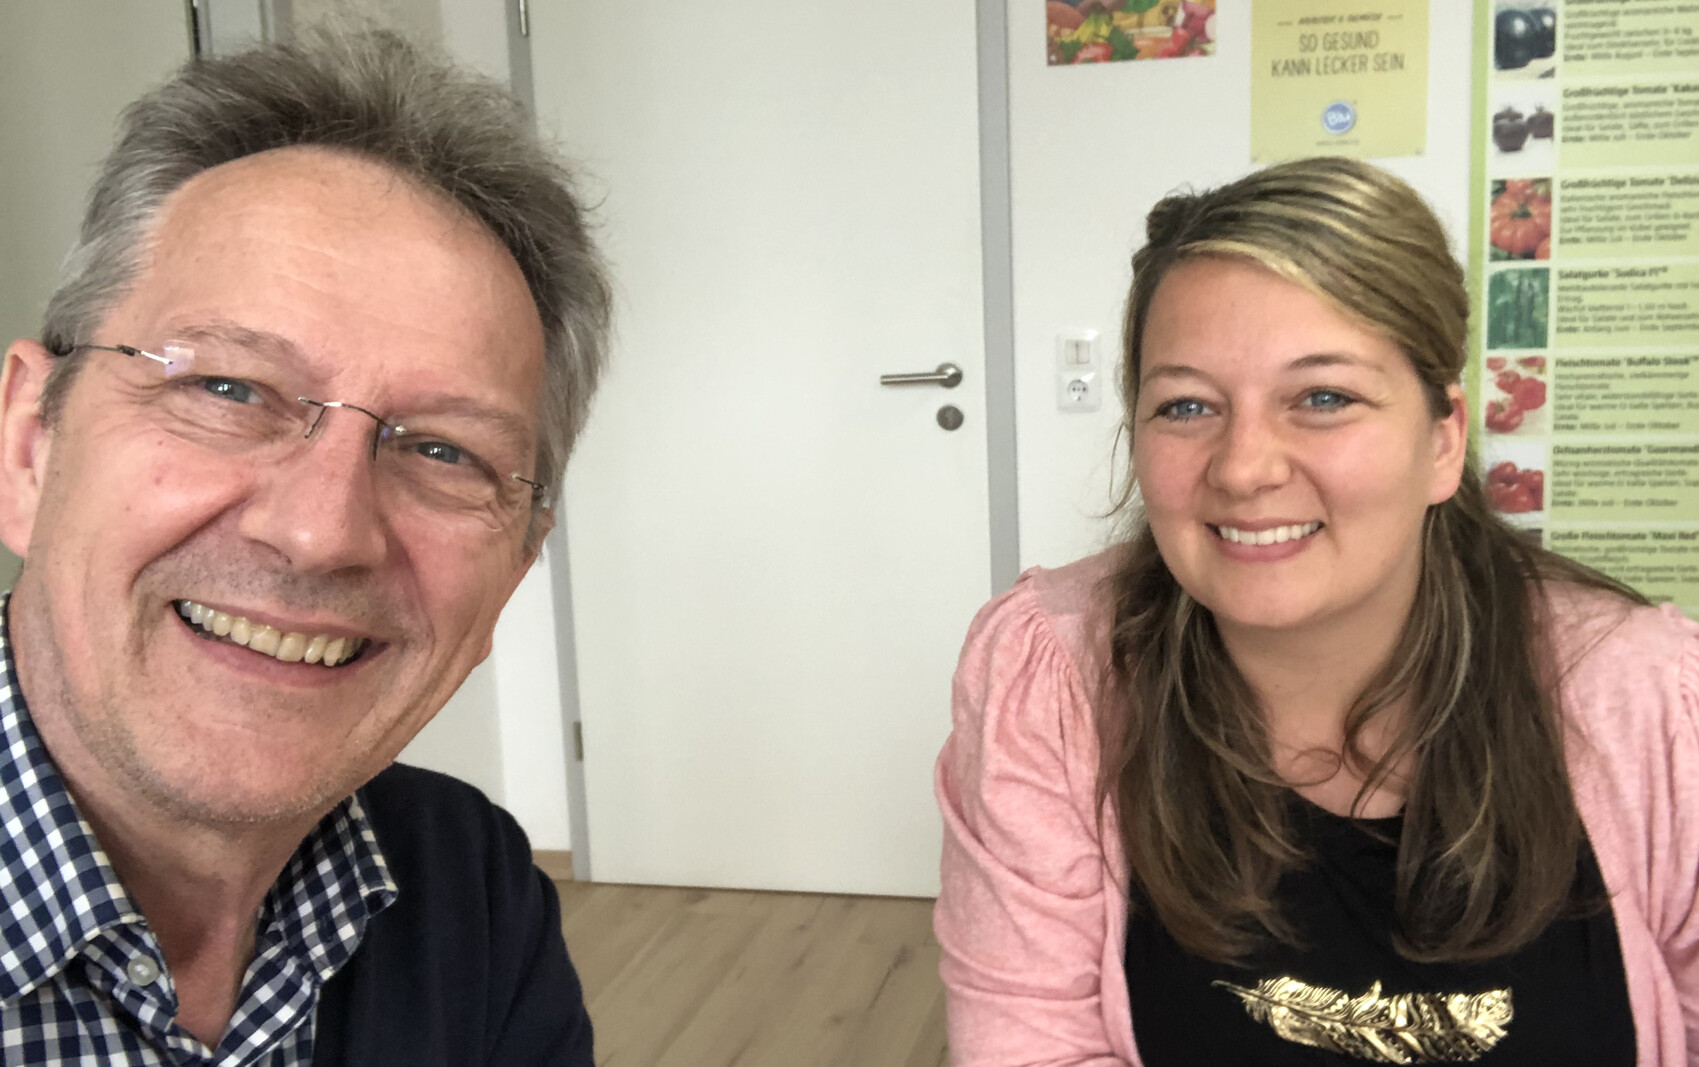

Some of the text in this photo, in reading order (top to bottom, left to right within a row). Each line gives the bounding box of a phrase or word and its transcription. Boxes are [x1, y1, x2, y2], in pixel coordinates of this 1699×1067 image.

[1299, 30, 1380, 52] SO GESUND
[1271, 53, 1405, 76] KANN LECKER SEIN
